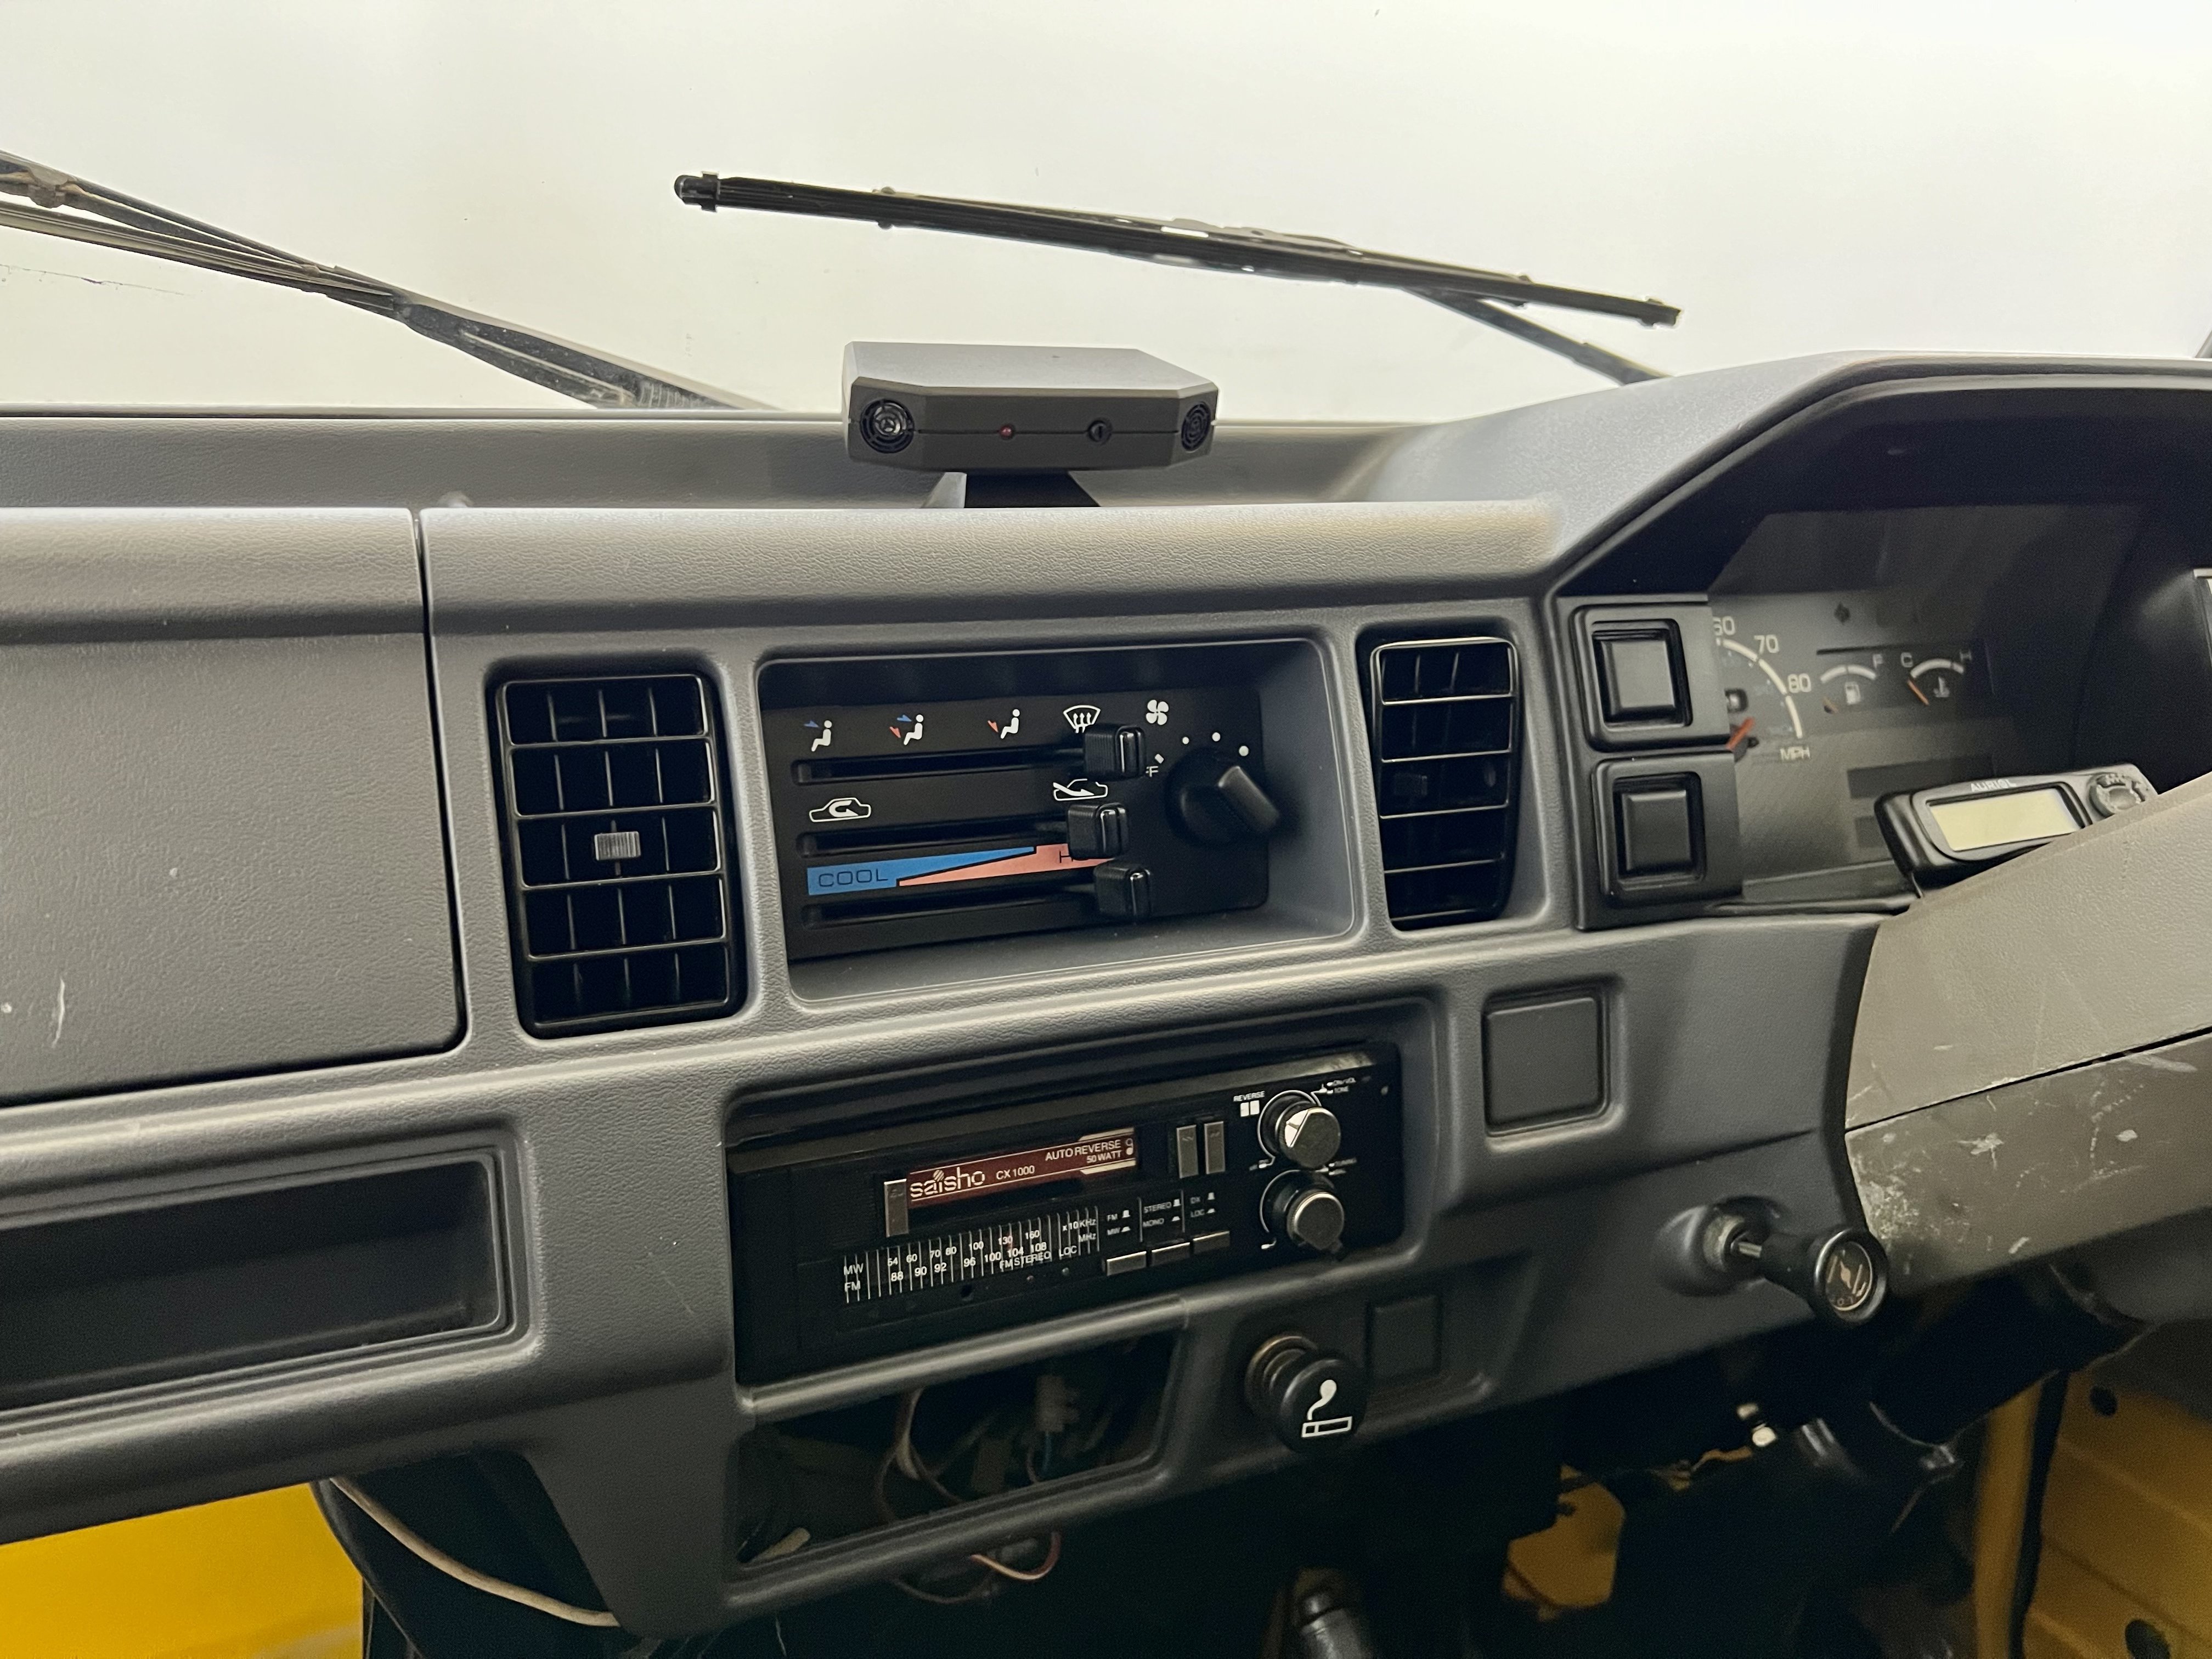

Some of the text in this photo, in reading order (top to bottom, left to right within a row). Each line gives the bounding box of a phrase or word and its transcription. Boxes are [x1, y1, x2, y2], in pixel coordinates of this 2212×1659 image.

[1754, 634, 1780, 654] 70
[1787, 673, 1812, 693] 80
[1780, 745, 1810, 761] MPH
[1971, 778, 2017, 792] AURIOL
[818, 868, 889, 888] COOL
[1045, 1139, 1121, 1161] AUTO REVERSE
[1086, 1150, 1122, 1164] 50 WATT
[910, 1167, 986, 1198] saisho
[1143, 1201, 1172, 1213] STEREO
[1107, 1213, 1118, 1222] FM
[1143, 1217, 1165, 1228] MONO
[1107, 1227, 1121, 1235] MW
[843, 1262, 864, 1276] MW
[906, 1254, 917, 1263] 60
[930, 1249, 941, 1260] 70
[945, 1246, 957, 1256] 80
[969, 1241, 984, 1251] 100
[998, 1235, 1013, 1245] 130
[1025, 1229, 1040, 1240] 160
[844, 1232, 1096, 1293] FM 88 90 92 96 100 104 108 MHz
[1000, 1245, 1077, 1269] FM STEREO LOC
